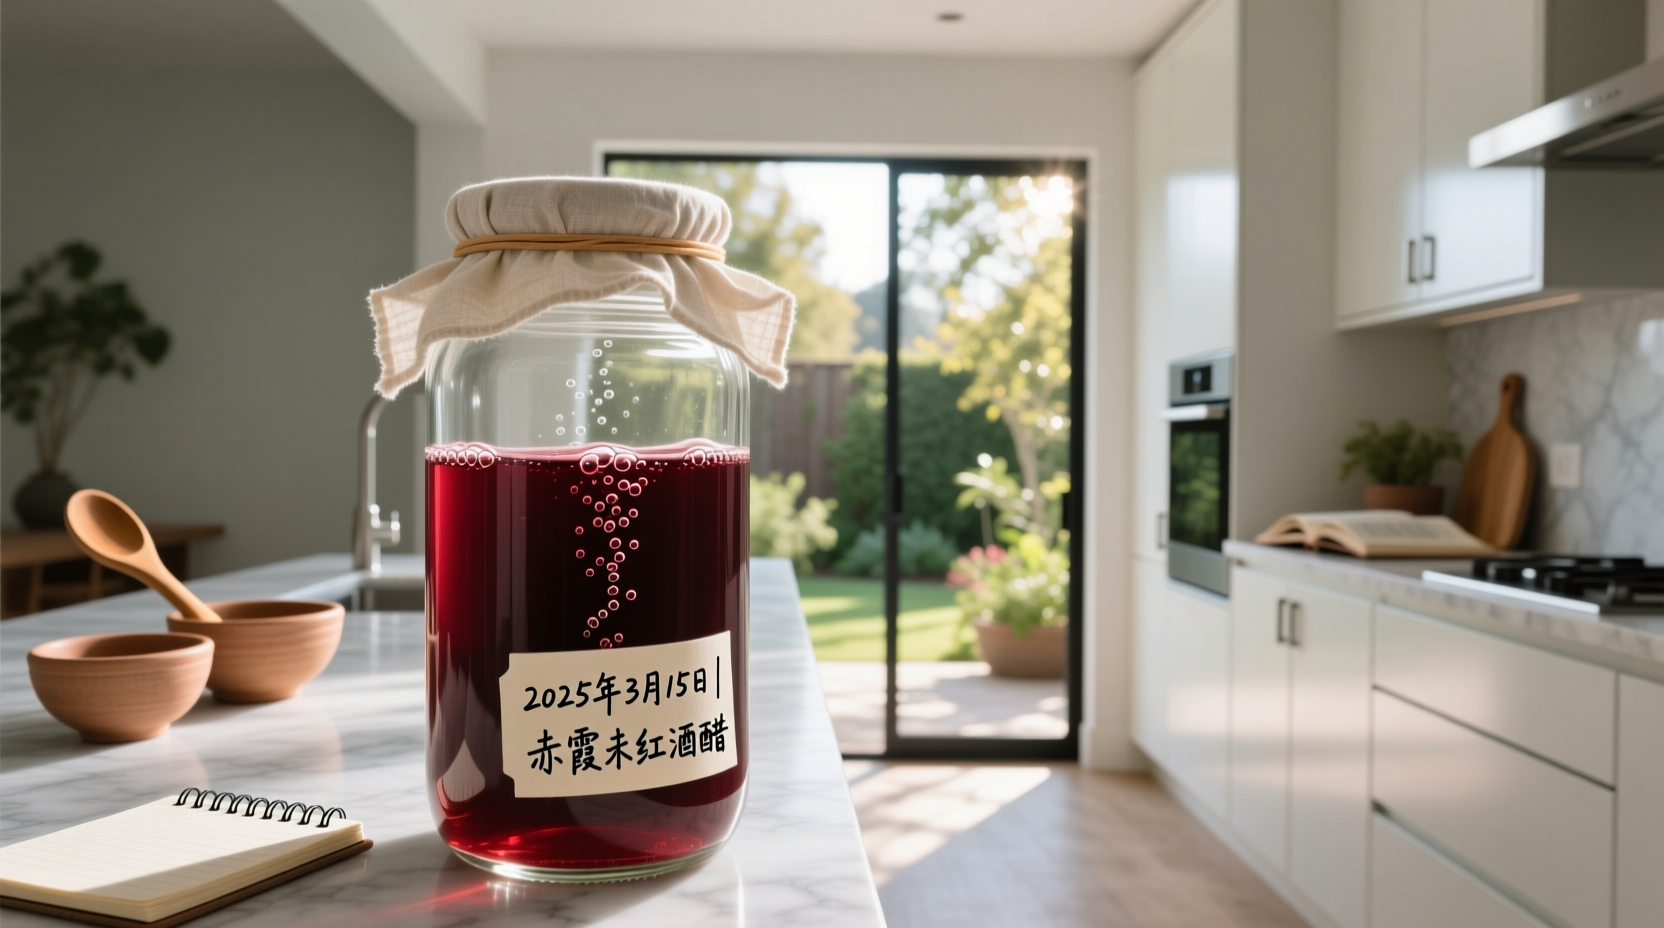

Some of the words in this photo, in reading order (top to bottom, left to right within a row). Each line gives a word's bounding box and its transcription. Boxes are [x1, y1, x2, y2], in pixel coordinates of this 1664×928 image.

[527, 713, 729, 775] 赤霞未红酒醋
